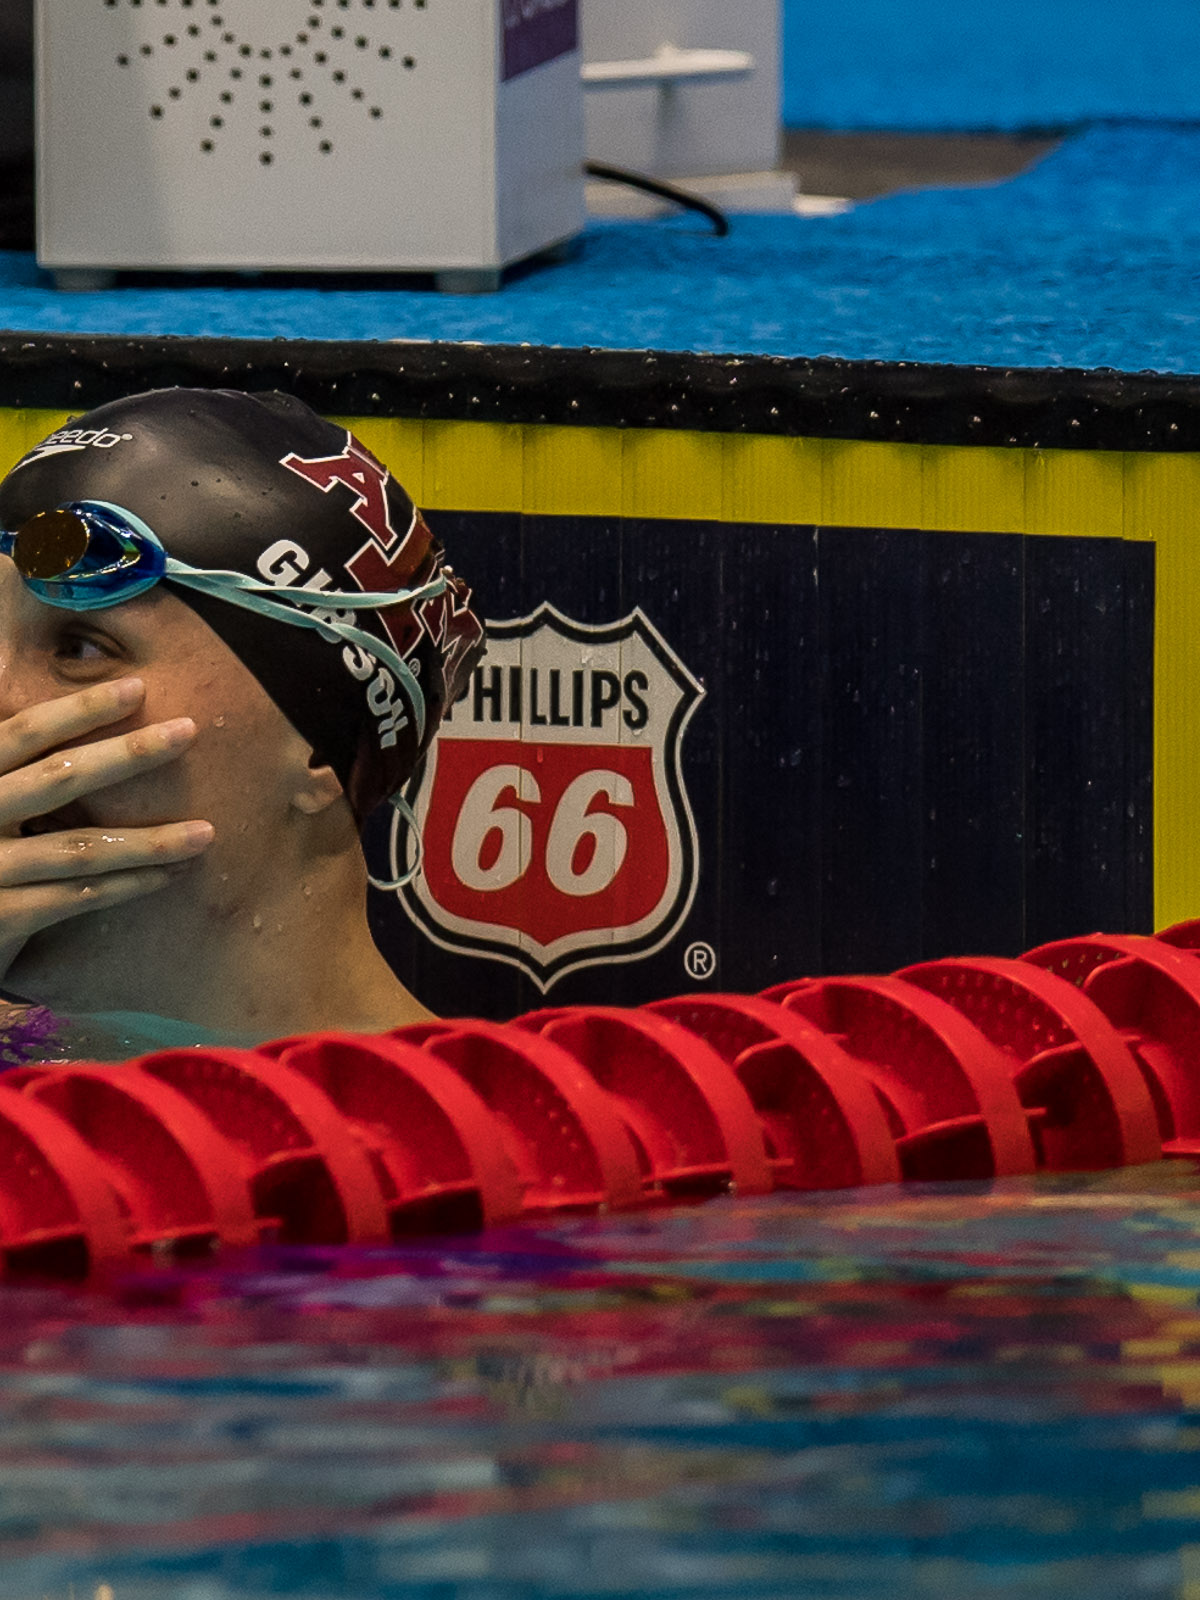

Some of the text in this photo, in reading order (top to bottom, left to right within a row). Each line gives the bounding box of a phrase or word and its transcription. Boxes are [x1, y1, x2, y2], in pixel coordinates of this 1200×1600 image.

[34, 427, 121, 448] eedo
[443, 665, 650, 730] HILLIPS
[451, 764, 635, 897] 66
